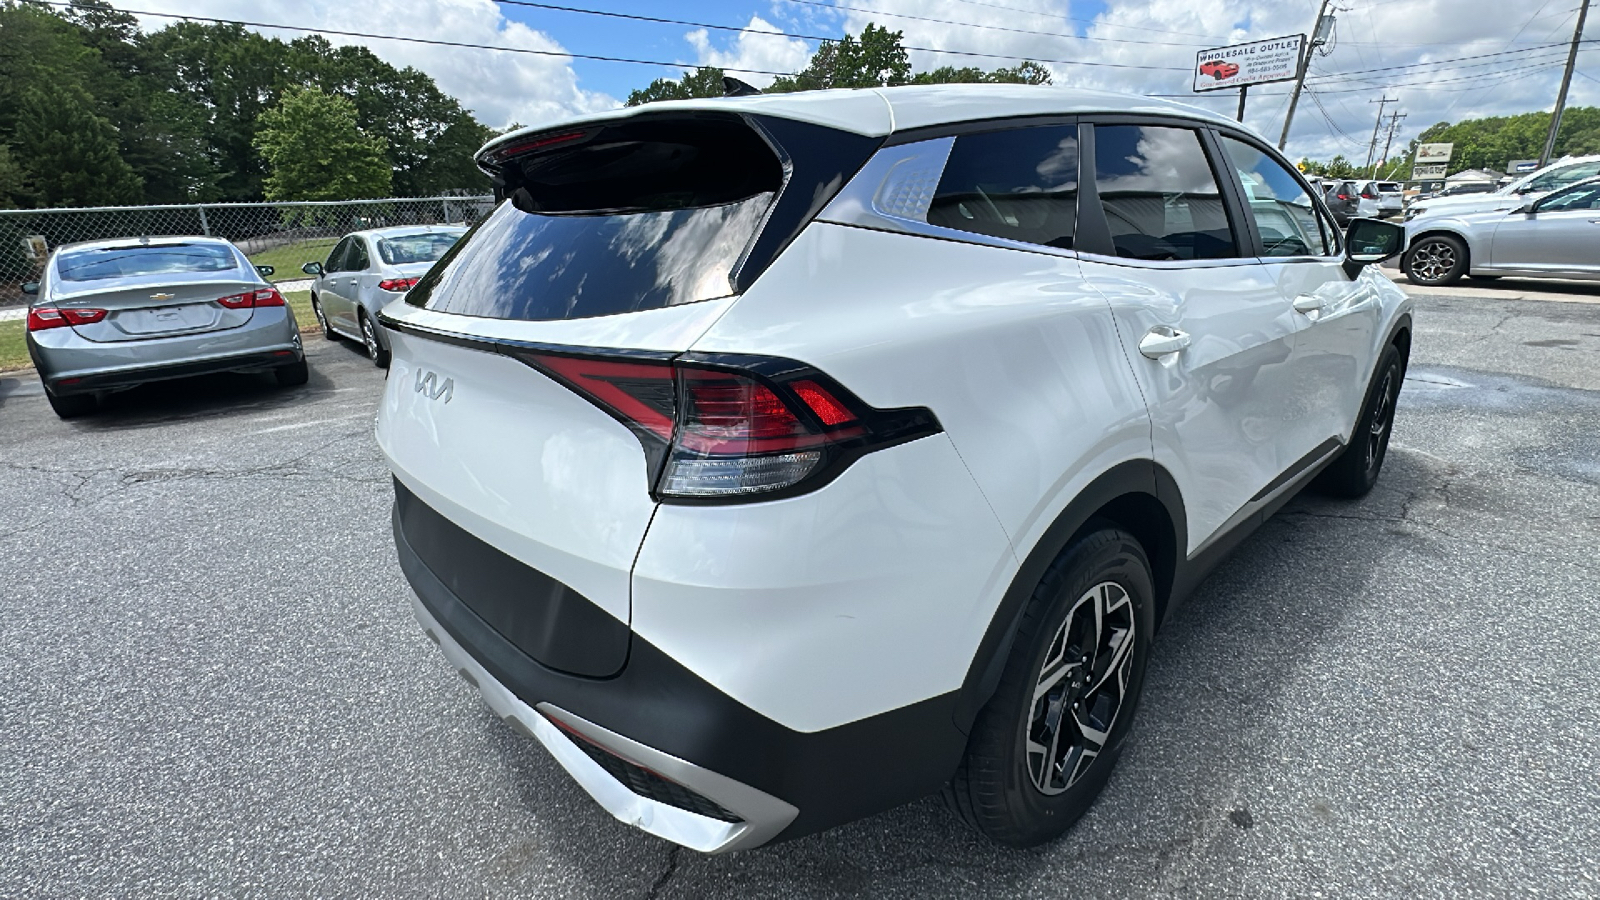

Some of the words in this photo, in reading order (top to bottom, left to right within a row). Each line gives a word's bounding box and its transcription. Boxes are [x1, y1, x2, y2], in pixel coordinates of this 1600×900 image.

[1200, 47, 1256, 62] WHOLESALE
[1260, 40, 1299, 53] OUTLET
[414, 368, 454, 404] KIA
